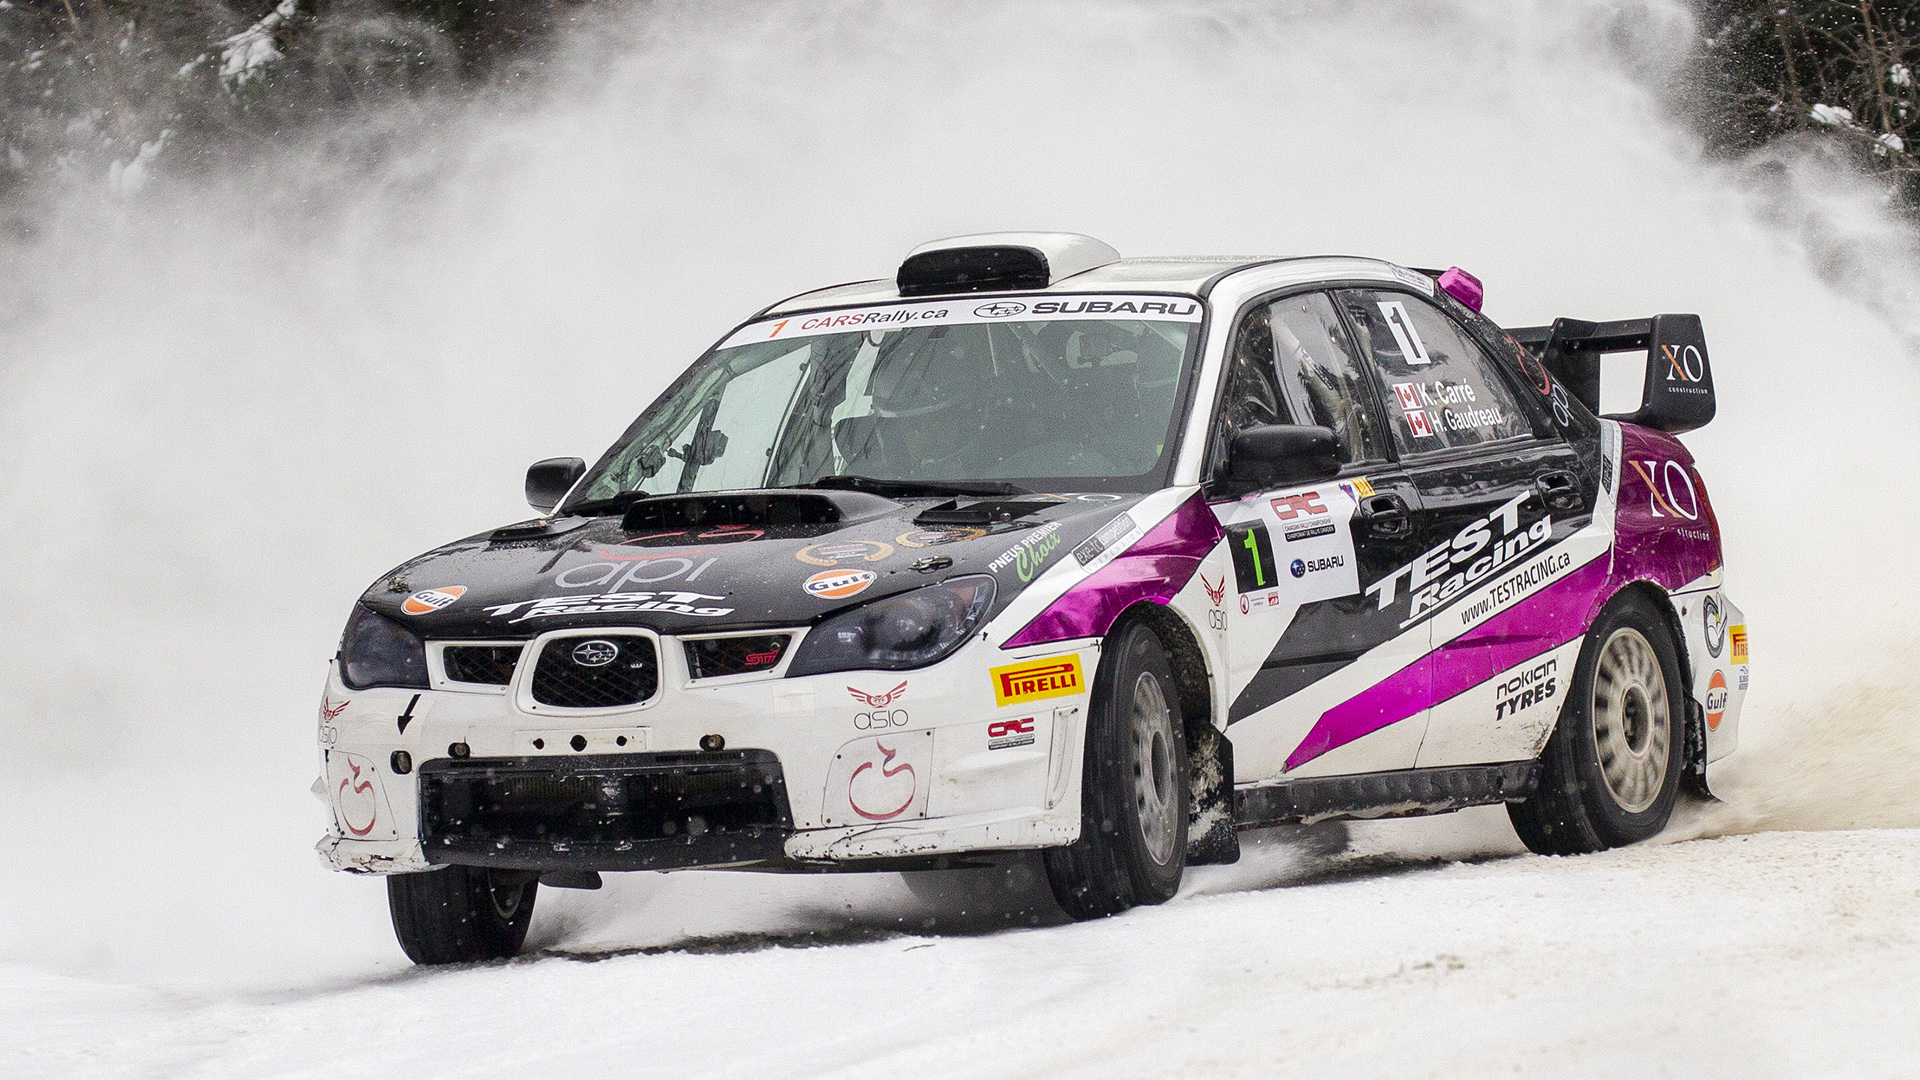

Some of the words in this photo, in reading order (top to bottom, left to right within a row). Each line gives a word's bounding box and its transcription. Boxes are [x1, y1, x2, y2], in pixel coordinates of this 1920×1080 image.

[768, 319, 790, 338] 1
[800, 307, 948, 331] CARSRally.ca
[1031, 302, 1197, 315] SUBARU
[1387, 304, 1423, 361] 1
[1661, 344, 1704, 382] XO
[1416, 382, 1437, 406] K.
[1434, 377, 1476, 405] Carré
[1428, 410, 1448, 433] H.
[1444, 404, 1503, 431] Gaudreau
[1628, 460, 1698, 520] XO
[988, 544, 1024, 573] PNEUS
[1021, 521, 1062, 548] PREMIER
[1098, 516, 1134, 546] competition
[1016, 532, 1061, 582] Choix
[1243, 529, 1264, 587] 1
[1307, 555, 1344, 573] SUBARU
[1366, 491, 1531, 611] TEST
[1407, 514, 1552, 621] Racing
[415, 591, 454, 606] Gulf
[808, 573, 872, 590] Gulf
[1461, 552, 1571, 625] www.TESTRACING.ca
[483, 592, 726, 616] TEST
[511, 601, 735, 621] Racing
[999, 663, 1077, 697] PIRELLI
[1497, 659, 1556, 700] nokian
[1496, 677, 1556, 721] TYRES
[1707, 692, 1727, 710] Gulf
